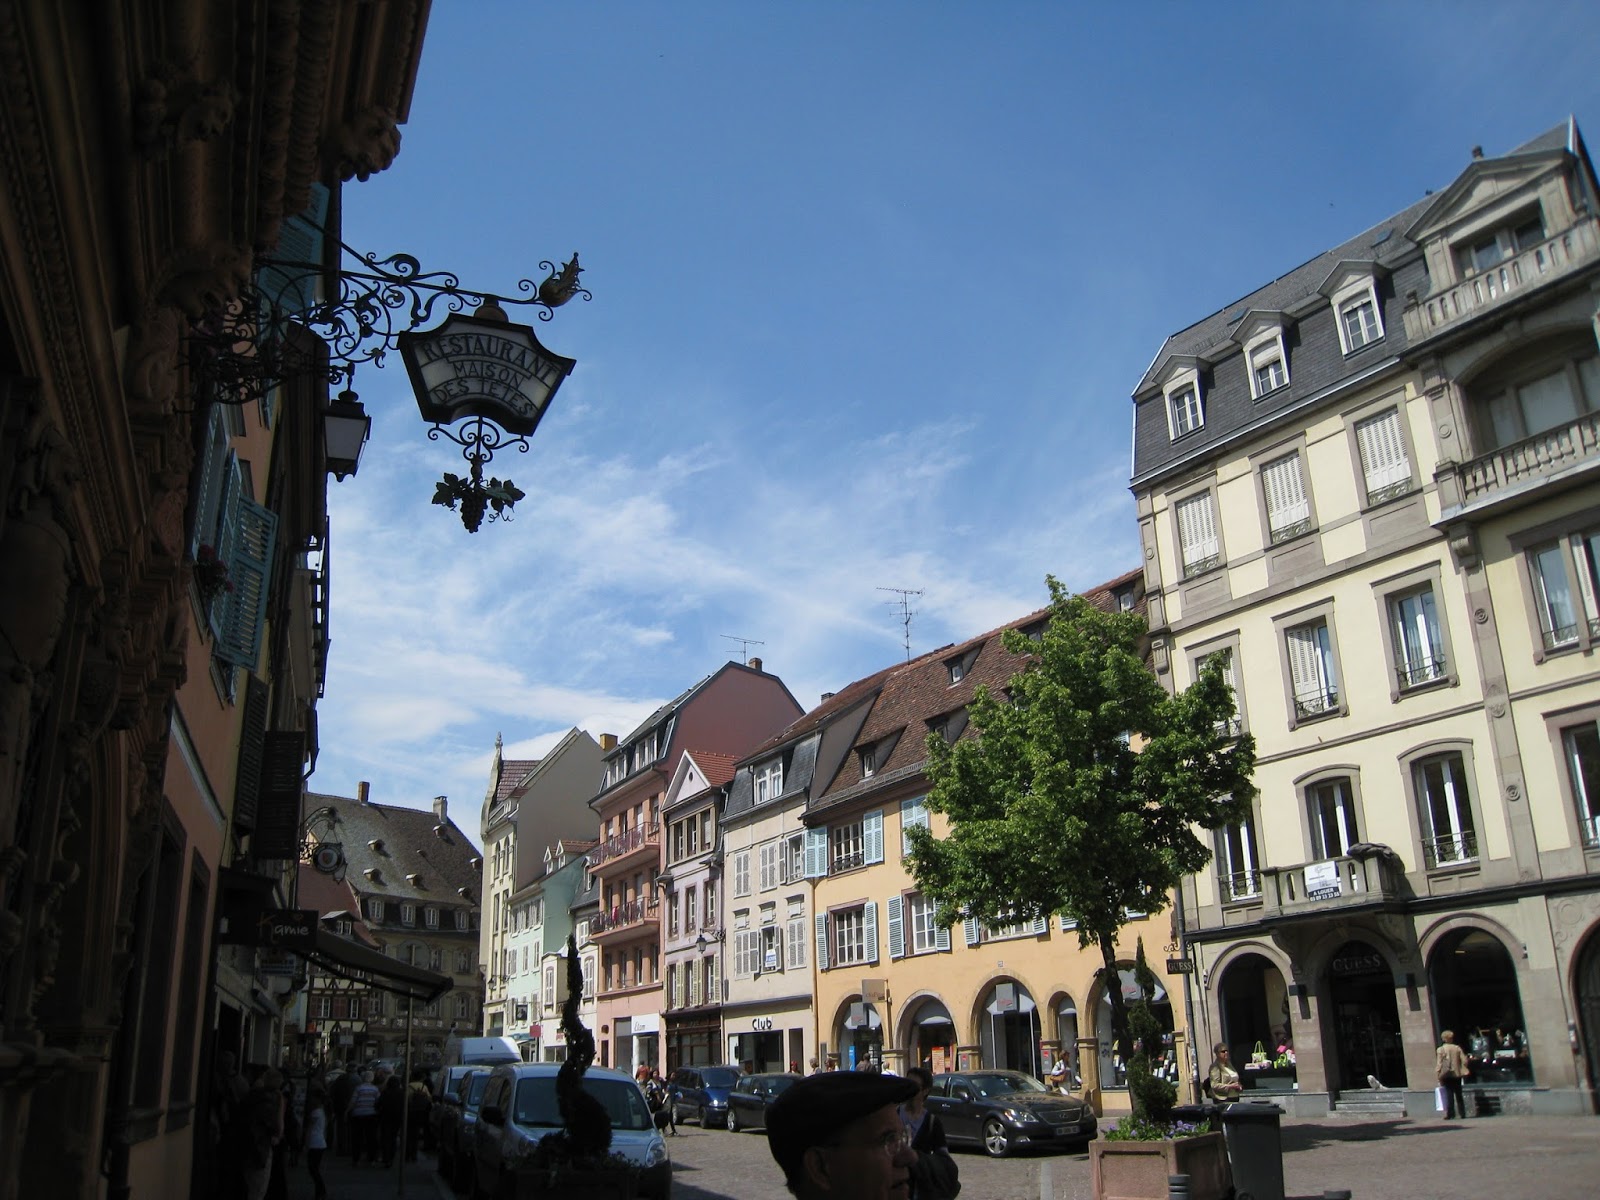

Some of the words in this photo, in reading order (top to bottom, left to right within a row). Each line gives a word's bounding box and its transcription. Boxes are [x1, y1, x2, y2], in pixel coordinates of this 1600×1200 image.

[422, 335, 557, 382] RESTAURANT
[453, 361, 527, 388] MAISON
[433, 379, 470, 402] DES
[1168, 961, 1192, 971] GUESS
[1333, 954, 1381, 971] GUESS
[752, 1016, 772, 1031] Club
